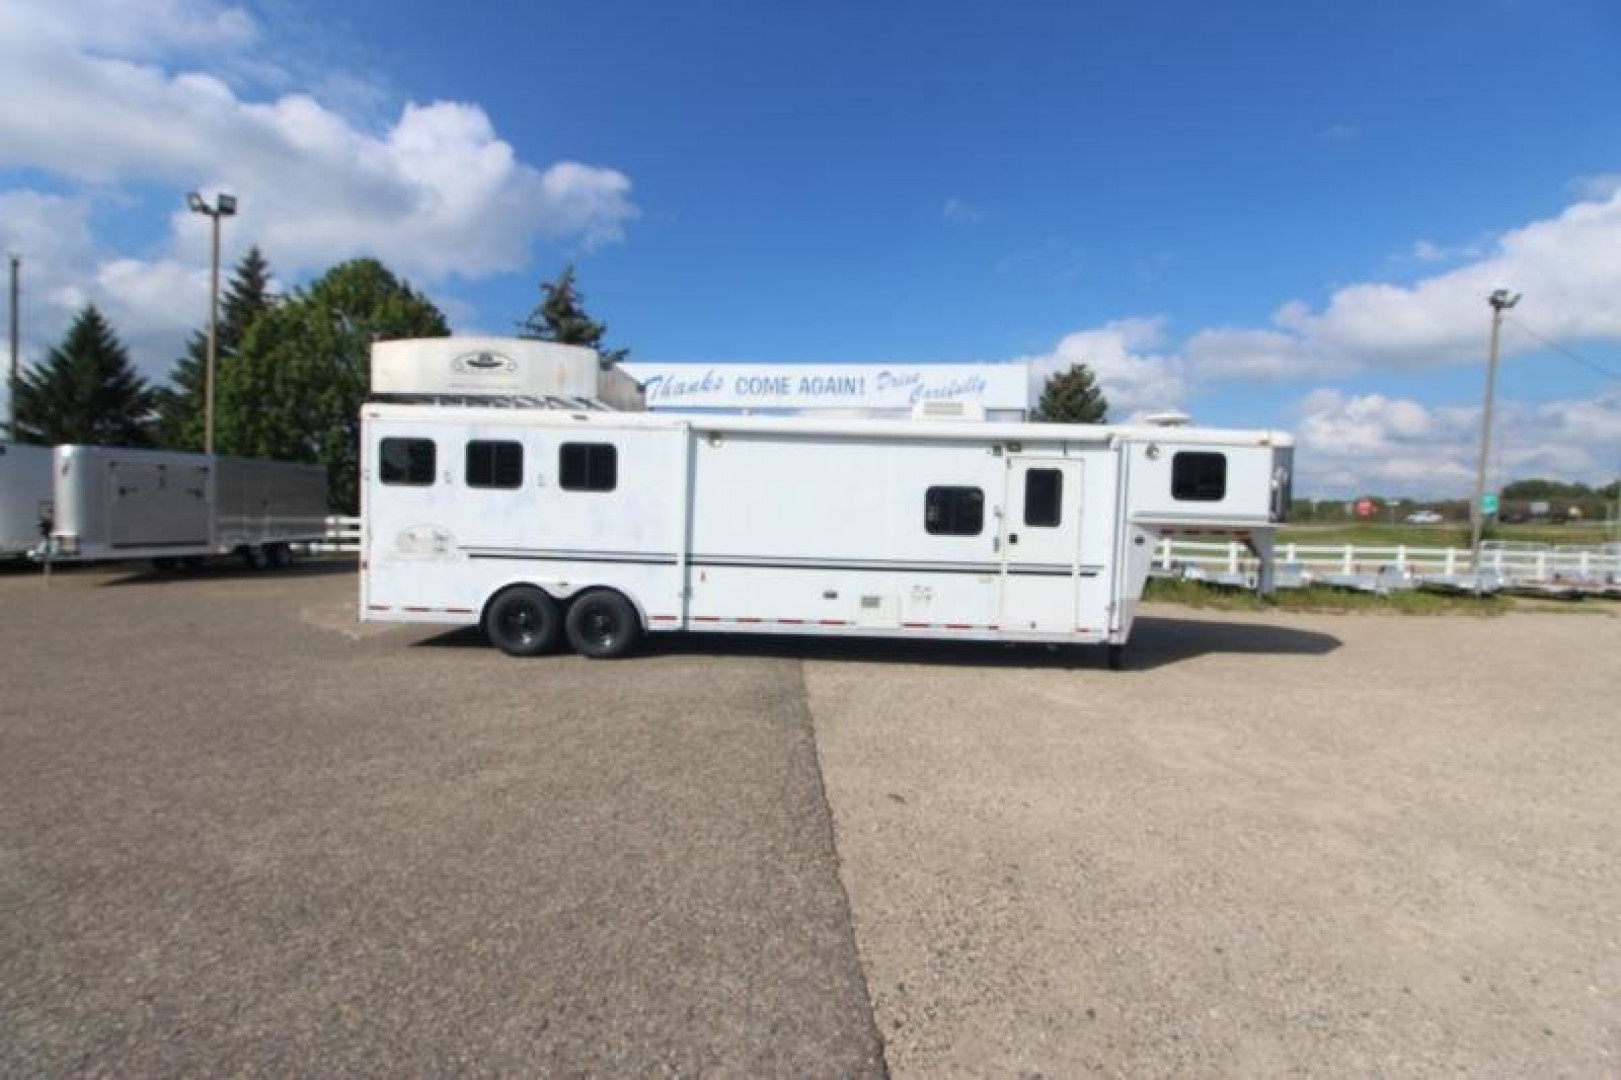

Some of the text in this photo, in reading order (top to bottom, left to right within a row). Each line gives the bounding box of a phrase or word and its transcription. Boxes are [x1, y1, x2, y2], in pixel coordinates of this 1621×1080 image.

[645, 370, 723, 399] Thanks
[736, 376, 865, 395] COME AGAIN!
[877, 371, 920, 390] Drive
[909, 374, 988, 404] Carefully
